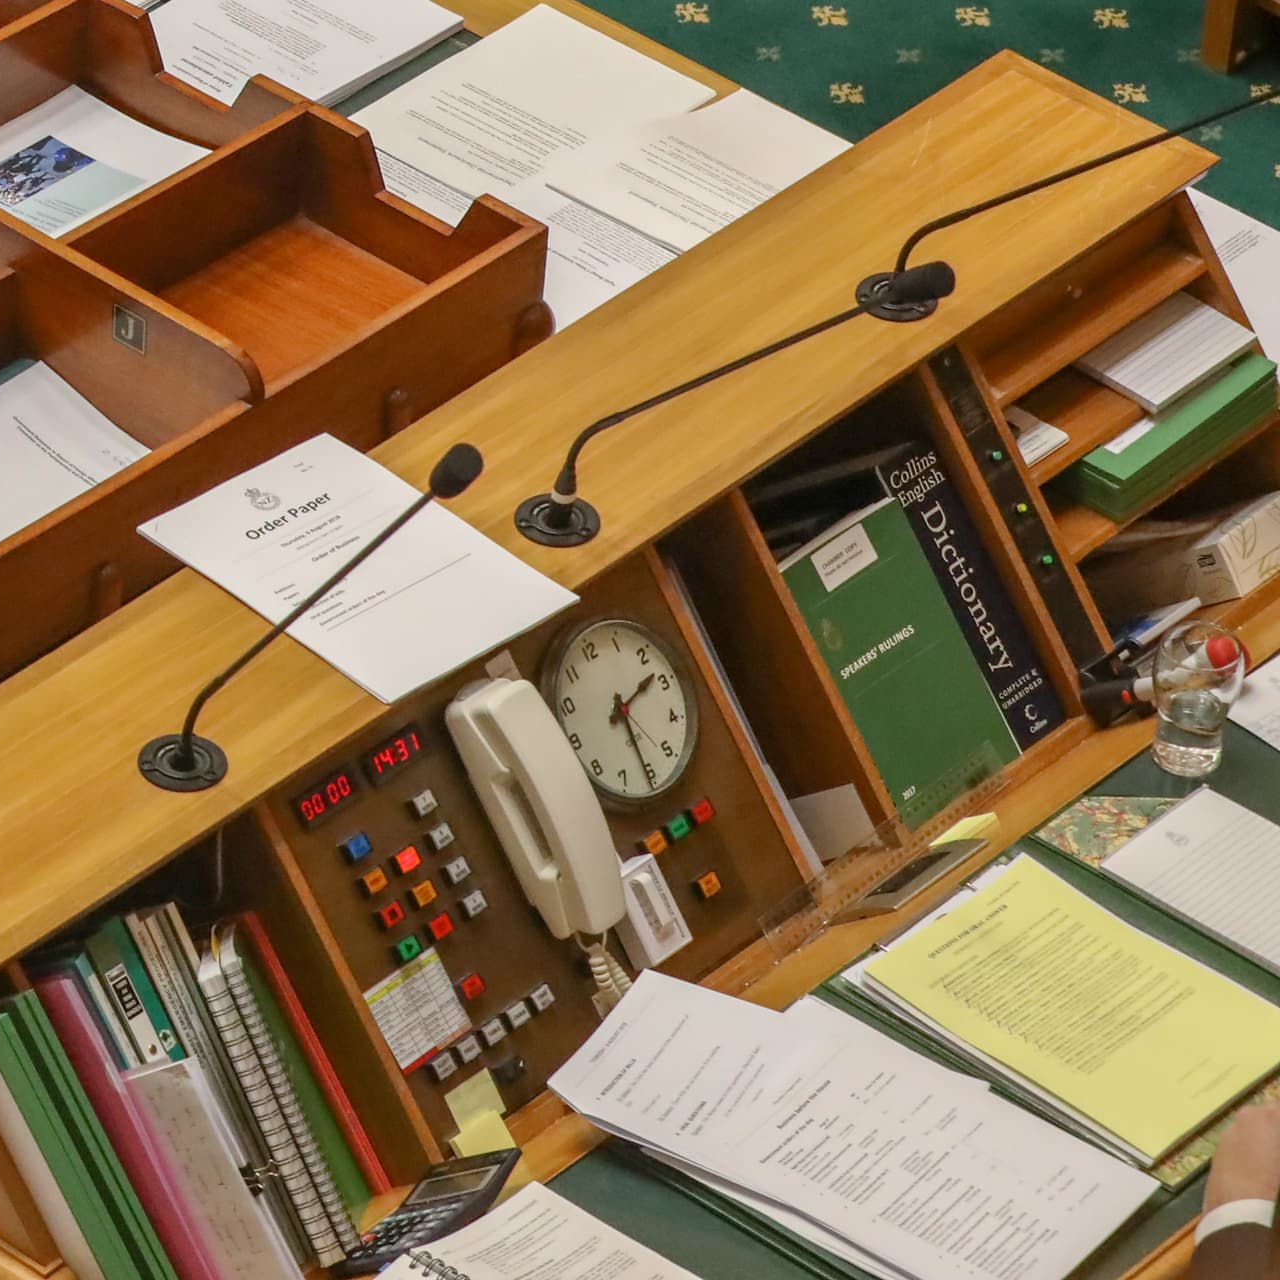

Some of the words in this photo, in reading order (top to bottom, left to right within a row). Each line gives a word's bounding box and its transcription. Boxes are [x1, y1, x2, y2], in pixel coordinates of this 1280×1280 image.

[120, 315, 135, 340] J
[890, 450, 937, 490] Collins
[896, 469, 946, 508] English
[245, 514, 289, 541] Order
[287, 492, 332, 518] Paper
[311, 550, 329, 563] Order
[329, 545, 336, 554] of
[335, 535, 361, 551] Business
[822, 551, 843, 570] CHAMBER
[844, 542, 857, 554] COPY
[920, 500, 1014, 672] Dictionary
[611, 637, 621, 653] 1
[878, 624, 915, 654] RULINGS
[581, 642, 599, 662] 12
[636, 647, 650, 665] 2
[565, 665, 579, 684] 11
[657, 674, 670, 691] 3
[998, 674, 1032, 700] COMPLETE
[1001, 677, 1044, 710] UNABRIDGED
[561, 697, 576, 717] 10
[669, 707, 679, 723] 4
[1029, 718, 1048, 735] Collins
[372, 732, 421, 774] 14:31
[568, 733, 582, 751] 9
[660, 740, 673, 758] 5
[590, 759, 604, 776] 8
[617, 769, 628, 786] 7
[160, 982, 189, 1031] EMERGENCY
[776, 1110, 795, 1130] Business
[793, 1097, 810, 1116] before
